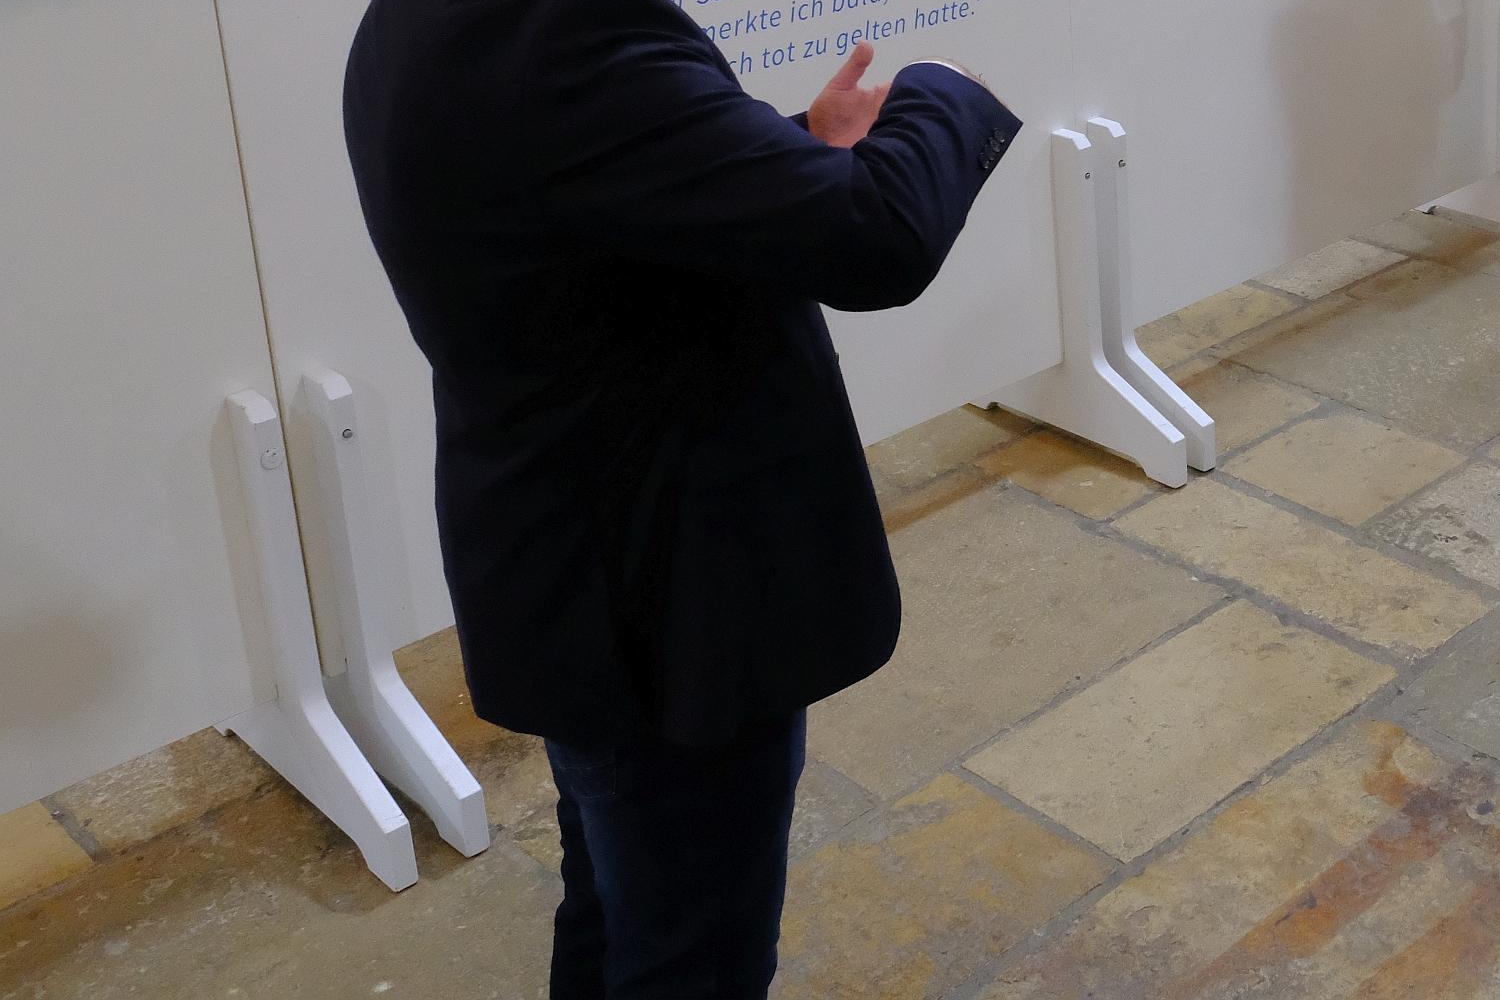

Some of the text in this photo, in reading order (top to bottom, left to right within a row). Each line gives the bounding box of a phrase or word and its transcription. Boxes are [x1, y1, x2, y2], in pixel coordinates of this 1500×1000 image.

[762, 41, 796, 69] tot
[803, 38, 828, 59] zu
[836, 18, 906, 56] gelten
